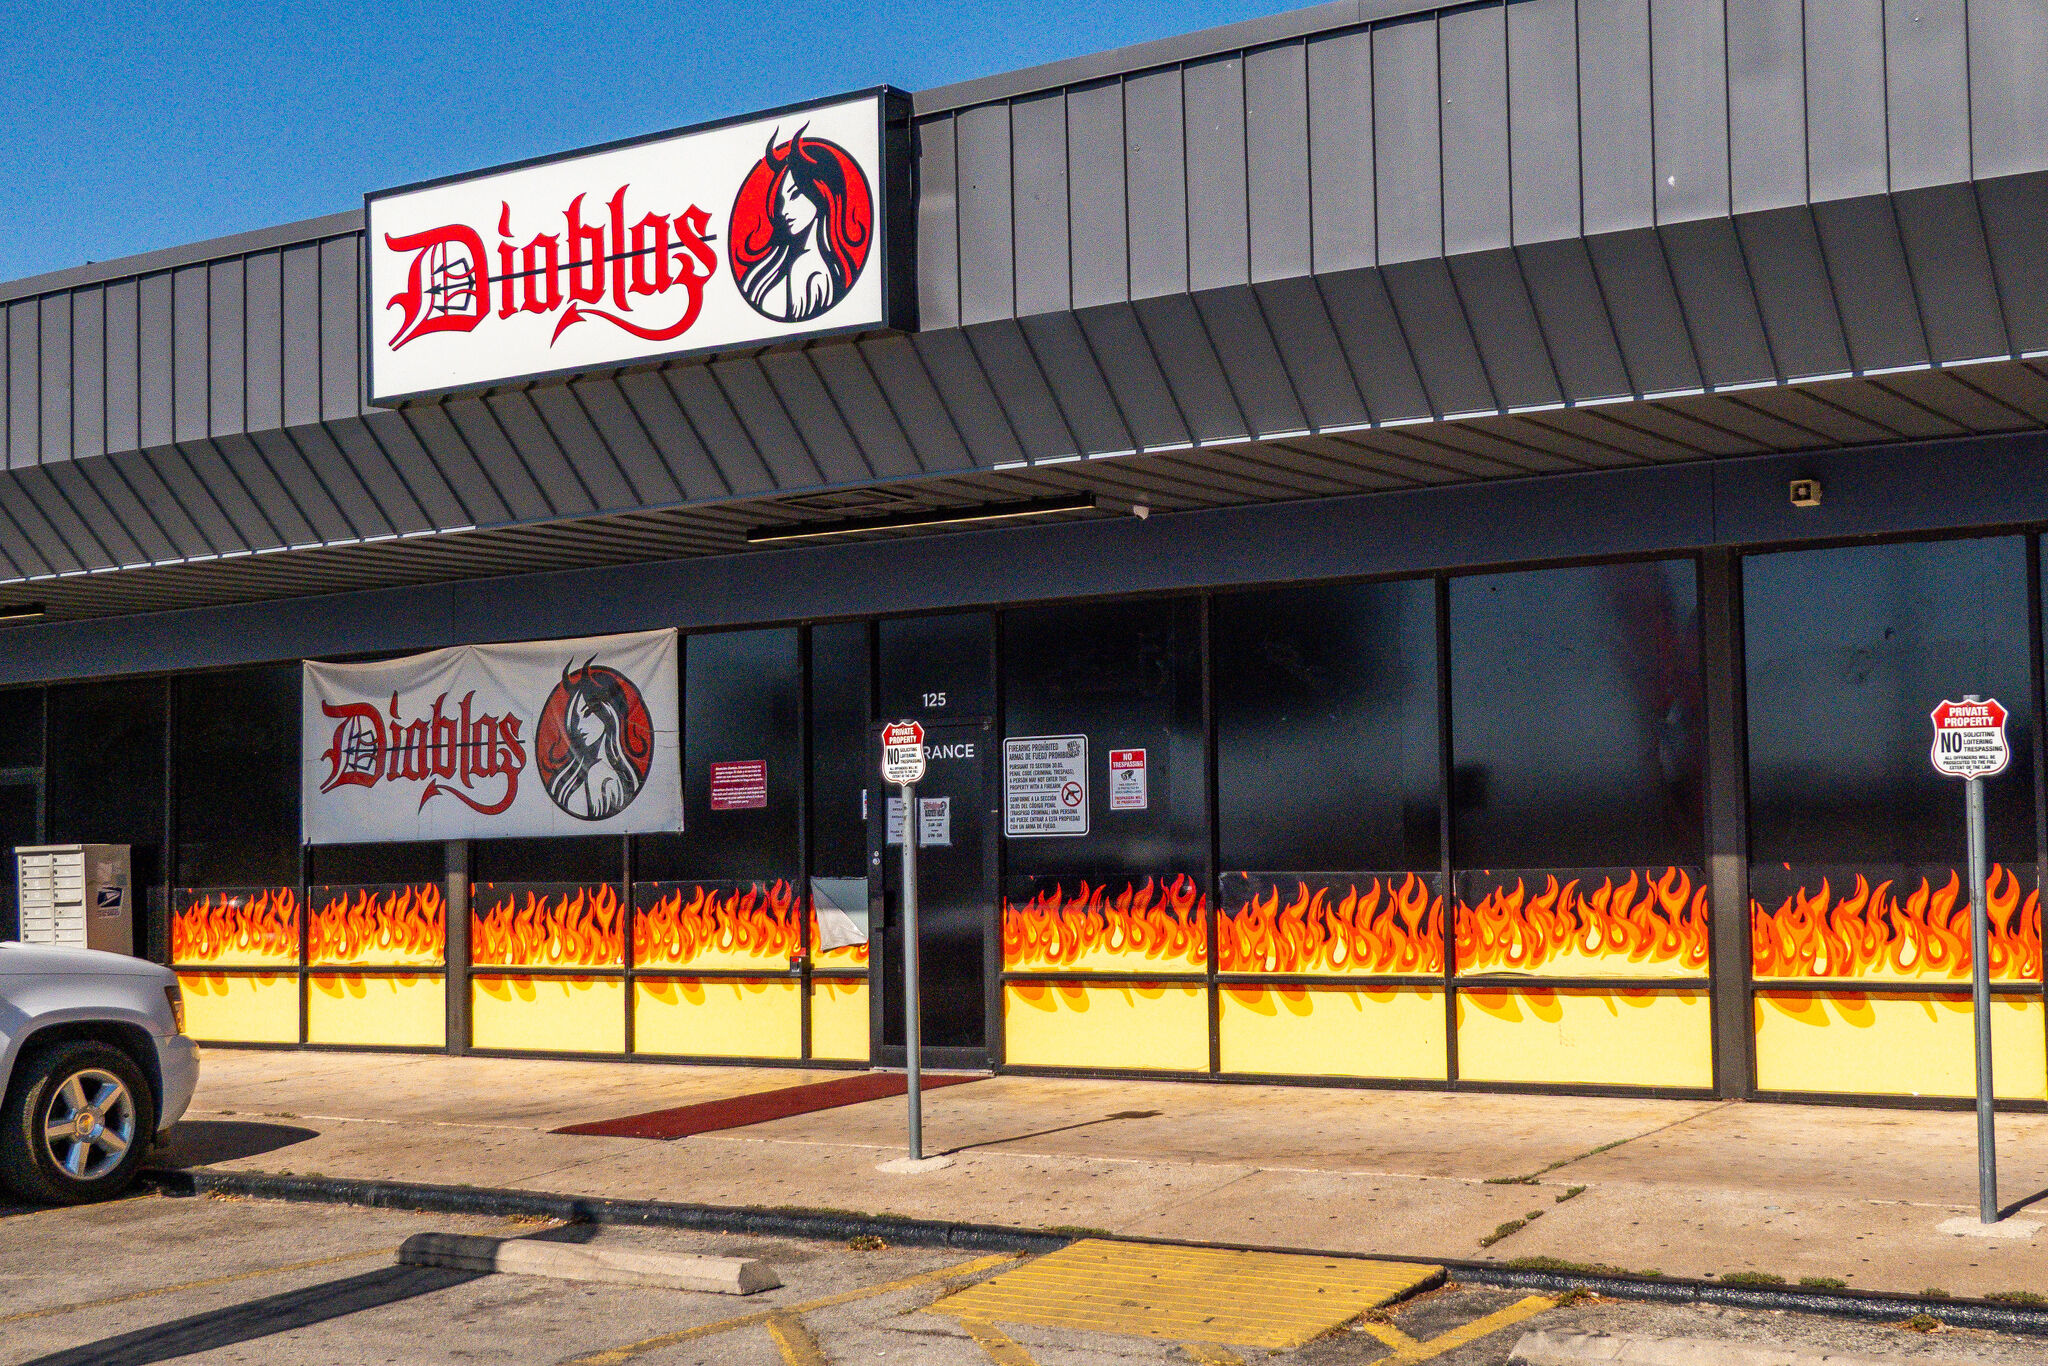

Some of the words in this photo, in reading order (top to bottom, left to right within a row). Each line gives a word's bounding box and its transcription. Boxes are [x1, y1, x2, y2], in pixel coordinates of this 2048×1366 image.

[923, 692, 946, 707] 125
[1949, 706, 1989, 717] PRIVATE
[1944, 716, 1994, 727] PROPERTY
[891, 727, 914, 736] PRIVATE
[889, 735, 917, 745] PROPERTY
[1940, 731, 1962, 753] NO
[923, 743, 975, 759] RANCE
[1009, 744, 1030, 752] FIREARMS
[1032, 742, 1058, 751] PROHIBITED
[887, 747, 900, 765] NO
[1009, 752, 1024, 761] ARMAS
[1025, 752, 1031, 760] DE
[1033, 751, 1047, 760] FUEGO
[1122, 752, 1133, 761] NO
[1112, 760, 1144, 769] TRESPASSING
